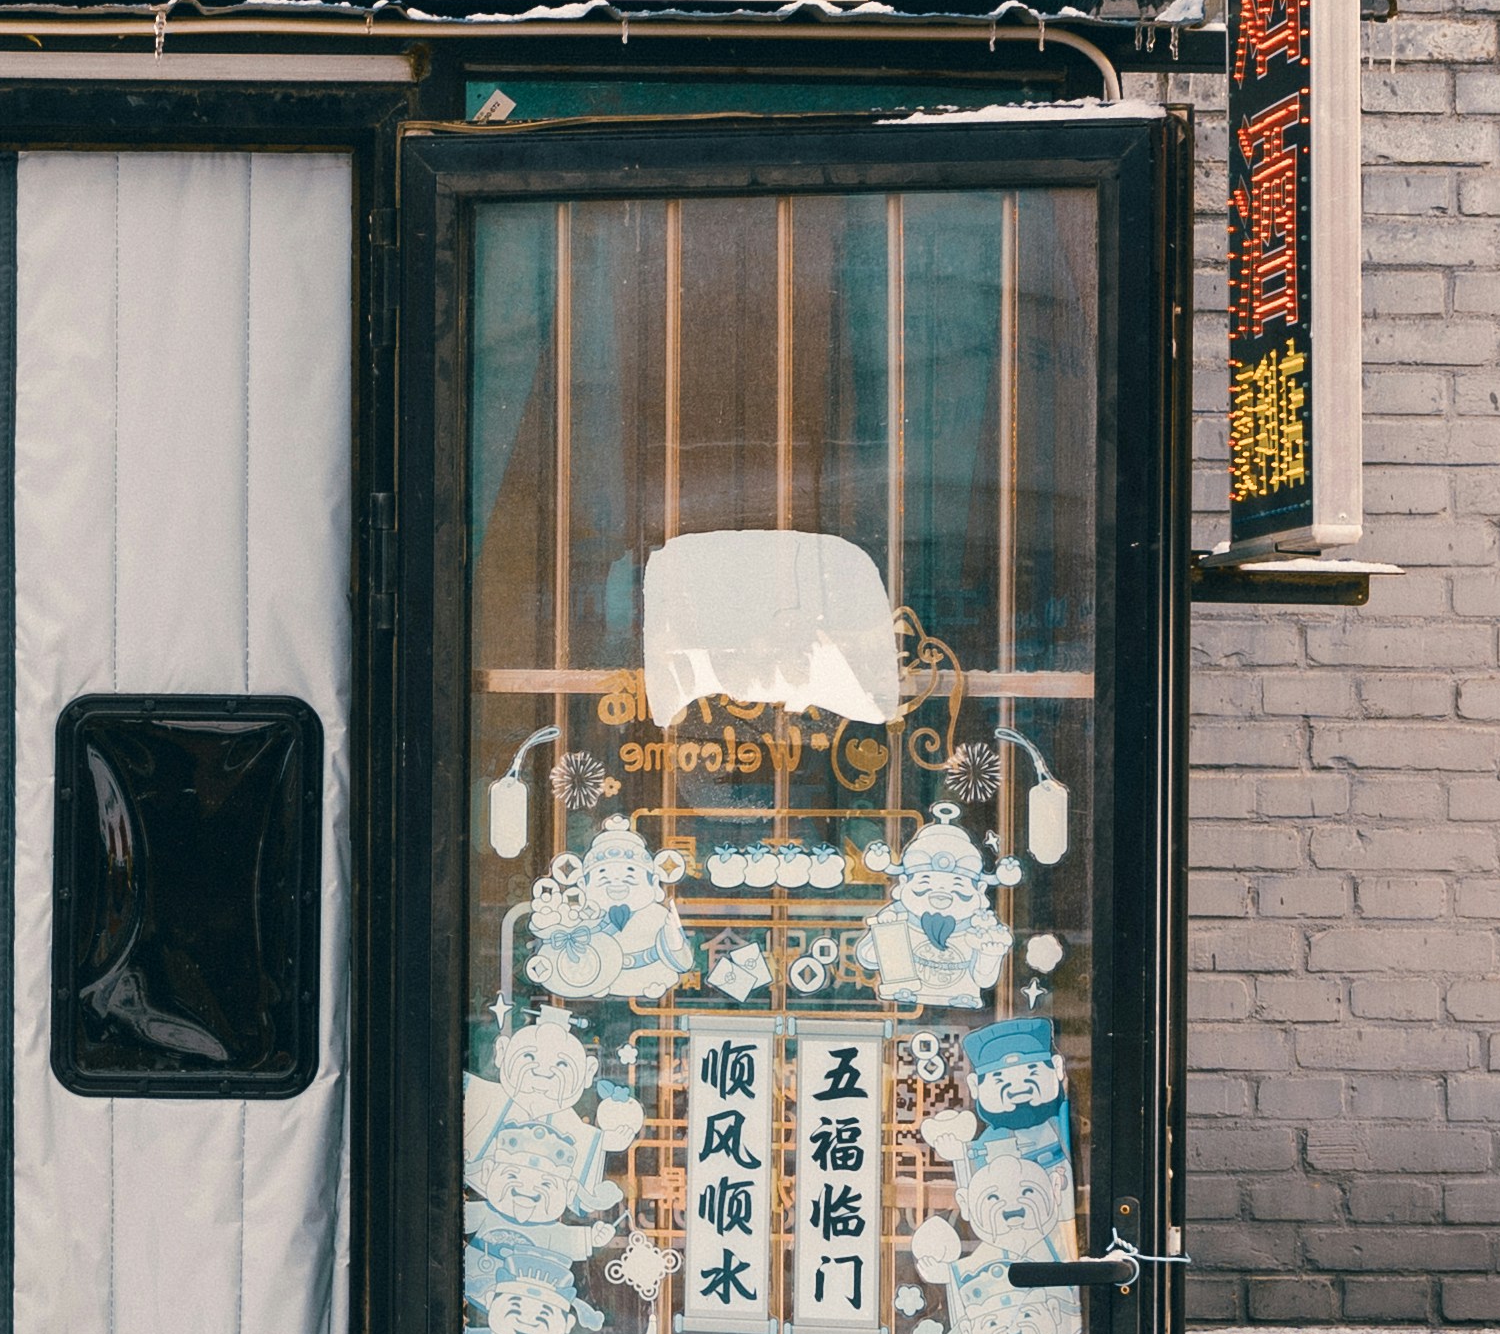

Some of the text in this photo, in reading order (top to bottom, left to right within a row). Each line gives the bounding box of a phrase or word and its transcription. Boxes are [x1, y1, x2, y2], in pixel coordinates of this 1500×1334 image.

[698, 1038, 762, 1305] 顺风顺水
[809, 1046, 869, 1310] 五福临门
